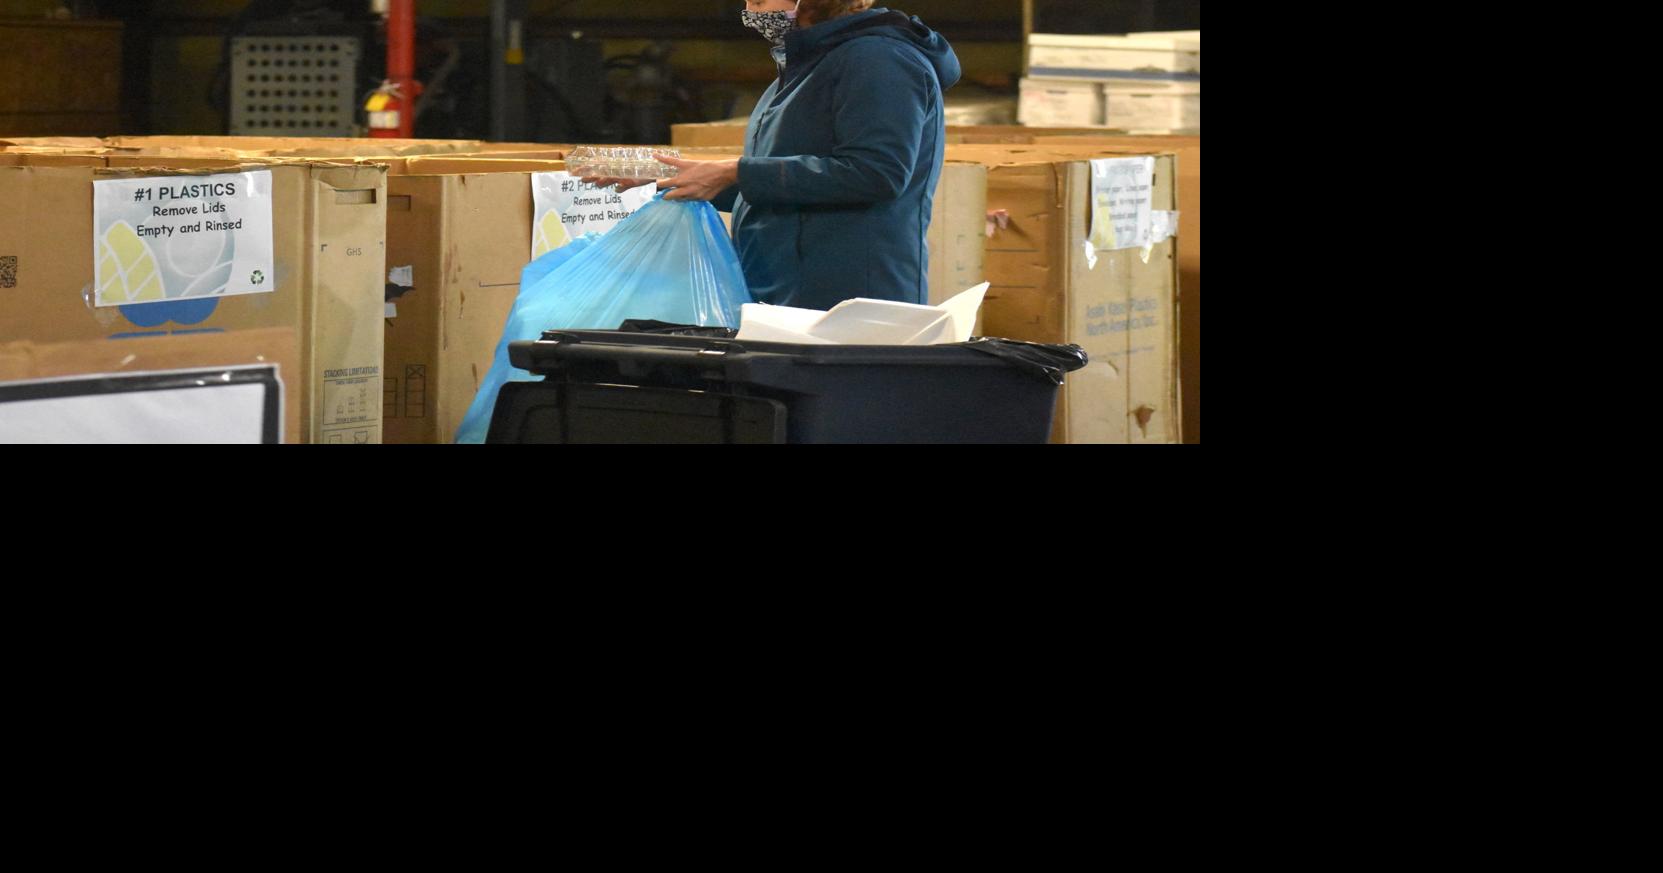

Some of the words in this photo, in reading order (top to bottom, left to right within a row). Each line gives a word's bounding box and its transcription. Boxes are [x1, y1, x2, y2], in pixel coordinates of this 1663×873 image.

[134, 188, 152, 202] #1
[159, 182, 236, 200] PLASTICS
[561, 180, 575, 192] #2
[573, 196, 602, 206] Remove
[605, 194, 622, 204] Lids
[152, 205, 198, 217] Remove
[202, 201, 226, 214] Lids
[561, 212, 586, 225] Empty
[589, 210, 605, 221] and
[136, 223, 175, 238] Empty
[180, 221, 201, 234] and
[205, 218, 242, 232] Rinsed
